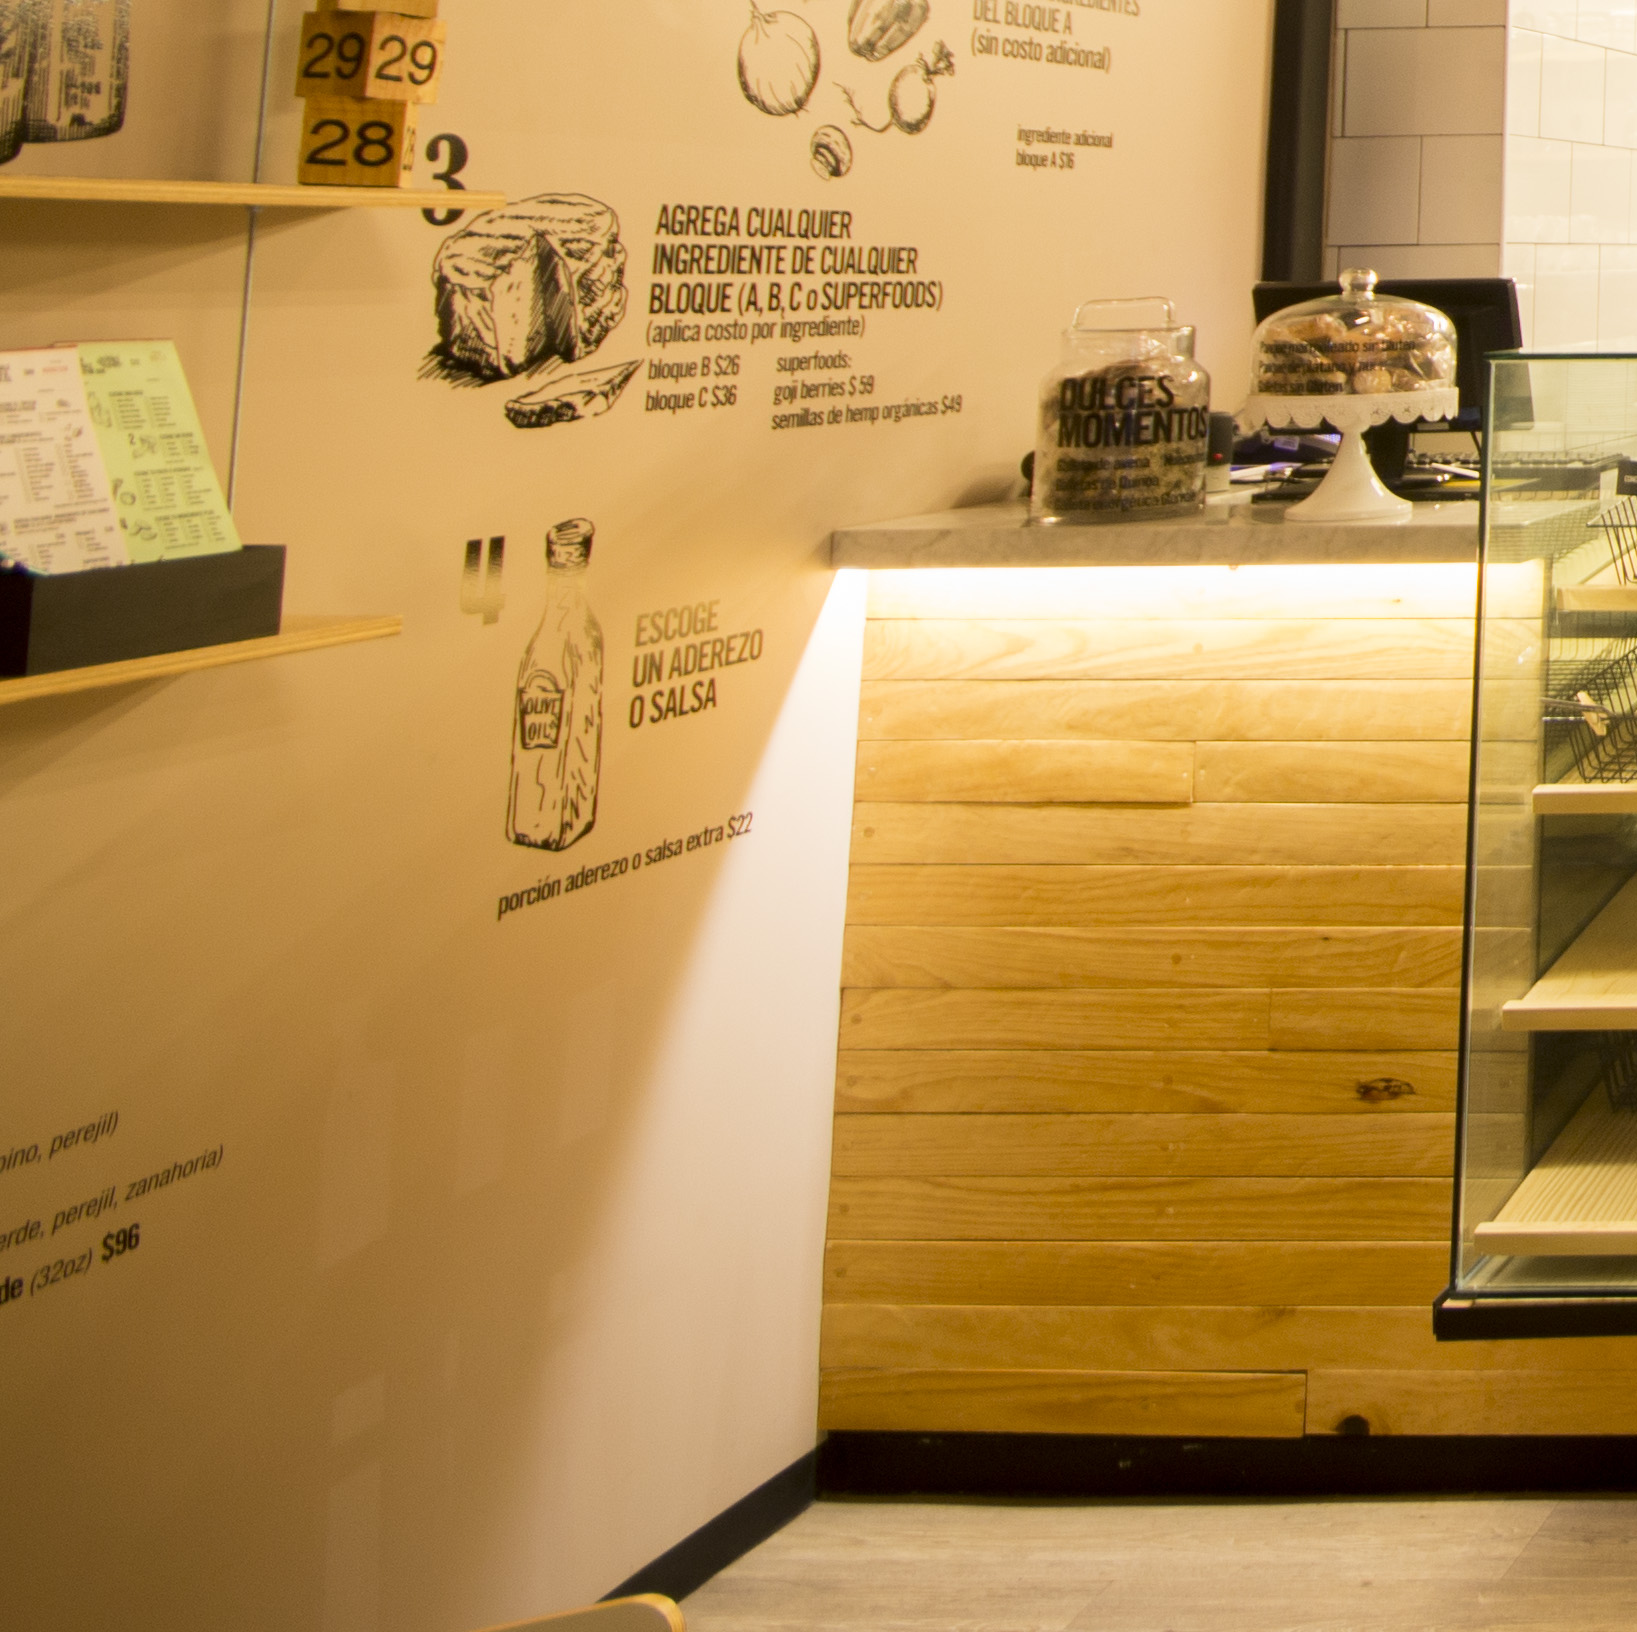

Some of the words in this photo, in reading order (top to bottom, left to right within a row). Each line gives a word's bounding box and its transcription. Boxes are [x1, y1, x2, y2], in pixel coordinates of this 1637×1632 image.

[1005, 1, 1060, 33] BLOQUE
[1063, 10, 1073, 35] A
[302, 32, 365, 79] 29
[376, 35, 438, 86] 29
[971, 28, 998, 56] (sin
[1002, 37, 1042, 61] costo
[1046, 40, 1111, 73] adicional)
[305, 119, 394, 166] 28
[422, 133, 468, 226] 3
[656, 204, 740, 236] AGREGA
[746, 207, 852, 239] CUALQUIER
[652, 243, 786, 275] INGREDIENTE
[791, 246, 817, 274] DE
[821, 246, 918, 274] CUALQUIER
[649, 281, 733, 315] BLOQUE
[738, 282, 763, 316] (A,
[768, 282, 785, 316] B,
[789, 282, 801, 311] C
[806, 288, 817, 311] o
[821, 281, 943, 311] SUPERFOODS)
[646, 320, 700, 348] (aplica
[705, 319, 747, 342] costo
[751, 321, 776, 347] por
[780, 313, 866, 343] ingrediente)
[647, 358, 697, 382] bloque
[701, 357, 710, 377] B
[714, 354, 740, 377] $26
[776, 350, 852, 373] superfoods:
[645, 389, 694, 414] bloque
[698, 389, 708, 408] C
[711, 386, 737, 407] $36
[771, 403, 824, 430] semillas
[846, 400, 879, 425] hemp
[882, 395, 938, 423] orgánicas
[1059, 375, 1174, 412] DULCES
[1057, 405, 1210, 448] MOMENTOS
[460, 536, 505, 625] 4
[635, 599, 721, 647] ESCOGE
[633, 652, 662, 688] UN
[668, 629, 764, 680] ADEREZO
[629, 694, 645, 728] O
[650, 677, 717, 725] SALSA
[498, 875, 560, 922] porción
[565, 856, 628, 894] aderezo
[632, 851, 641, 870] o
[645, 836, 682, 866] salsa
[686, 821, 723, 851] extra
[727, 811, 753, 839] $22
[49, 1111, 118, 1159] perejil)
[52, 1186, 117, 1236] perejil,
[125, 1143, 223, 1202] zanahoria)
[30, 1247, 92, 1296] (32oz)
[101, 1223, 140, 1263] $96
